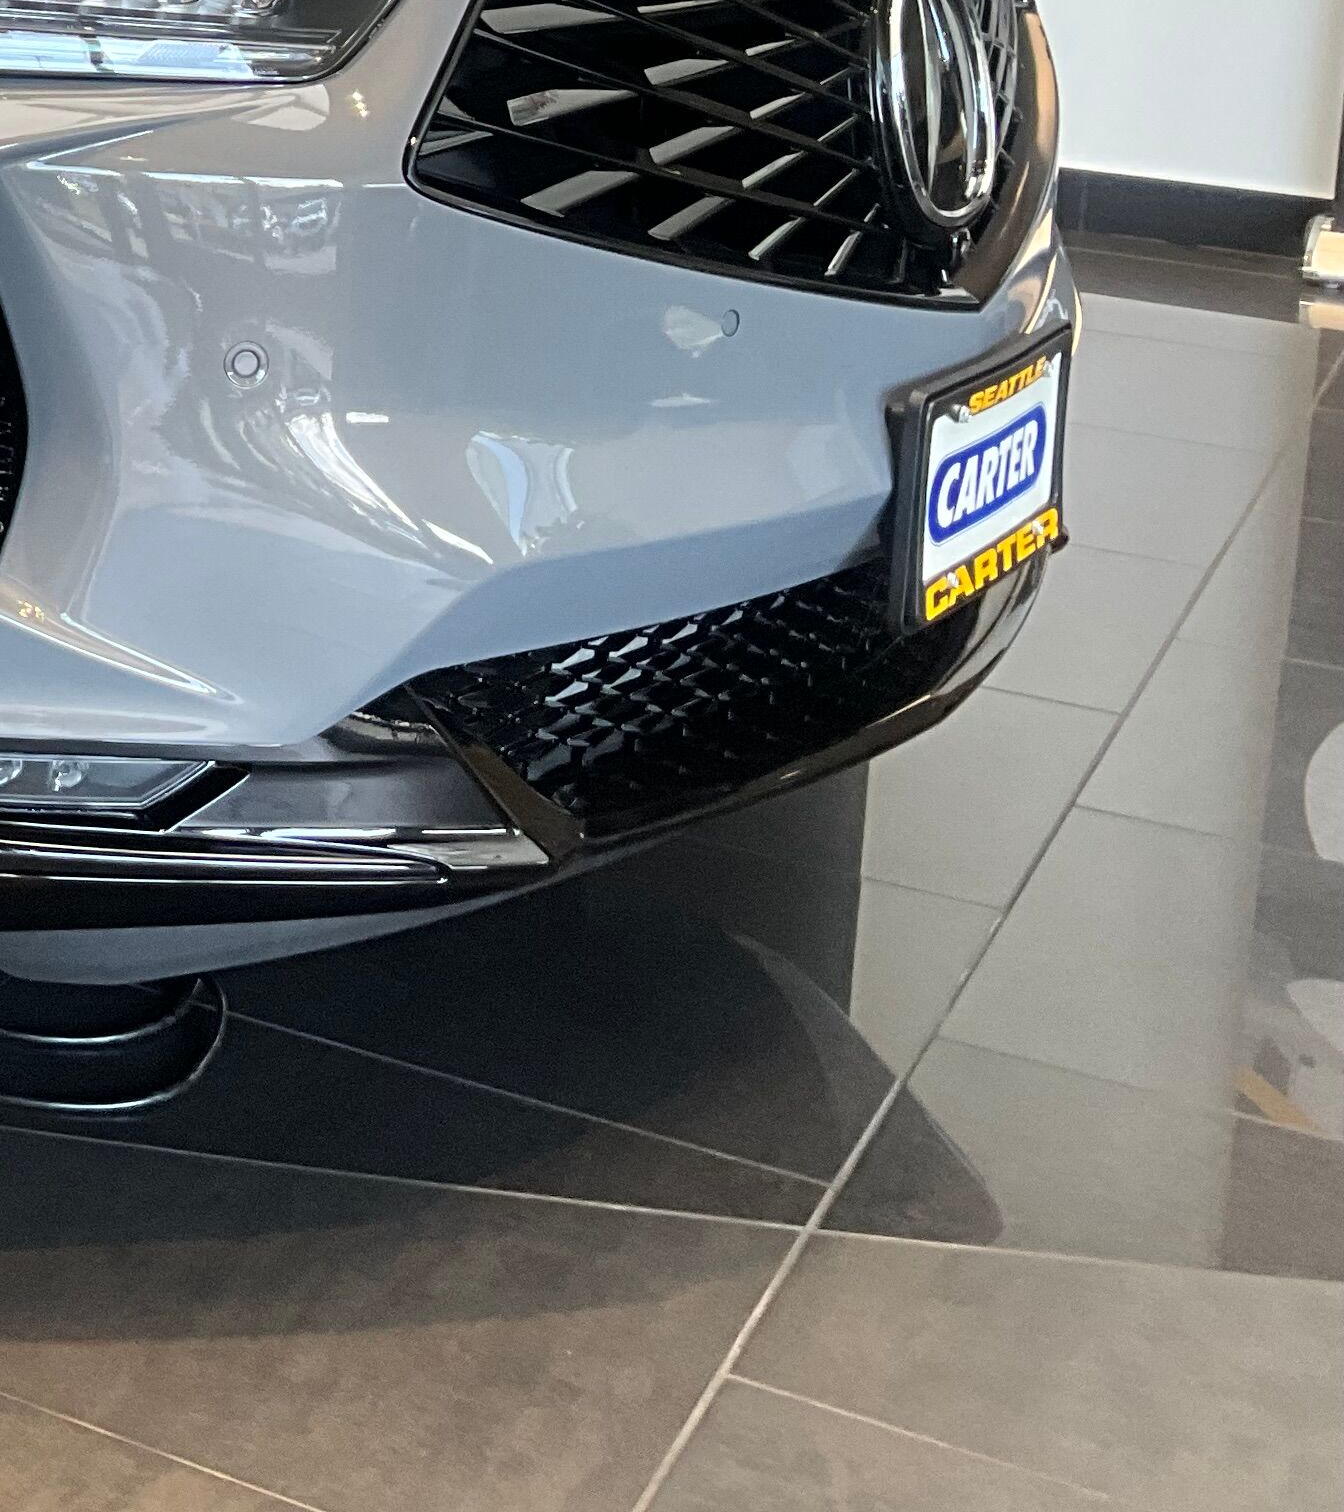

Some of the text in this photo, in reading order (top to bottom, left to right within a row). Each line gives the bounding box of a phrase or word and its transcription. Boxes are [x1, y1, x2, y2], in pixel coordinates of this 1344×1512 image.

[969, 356, 1046, 414] SEATTLE
[937, 419, 1039, 528] CARTER
[925, 507, 1058, 621] CARTER
